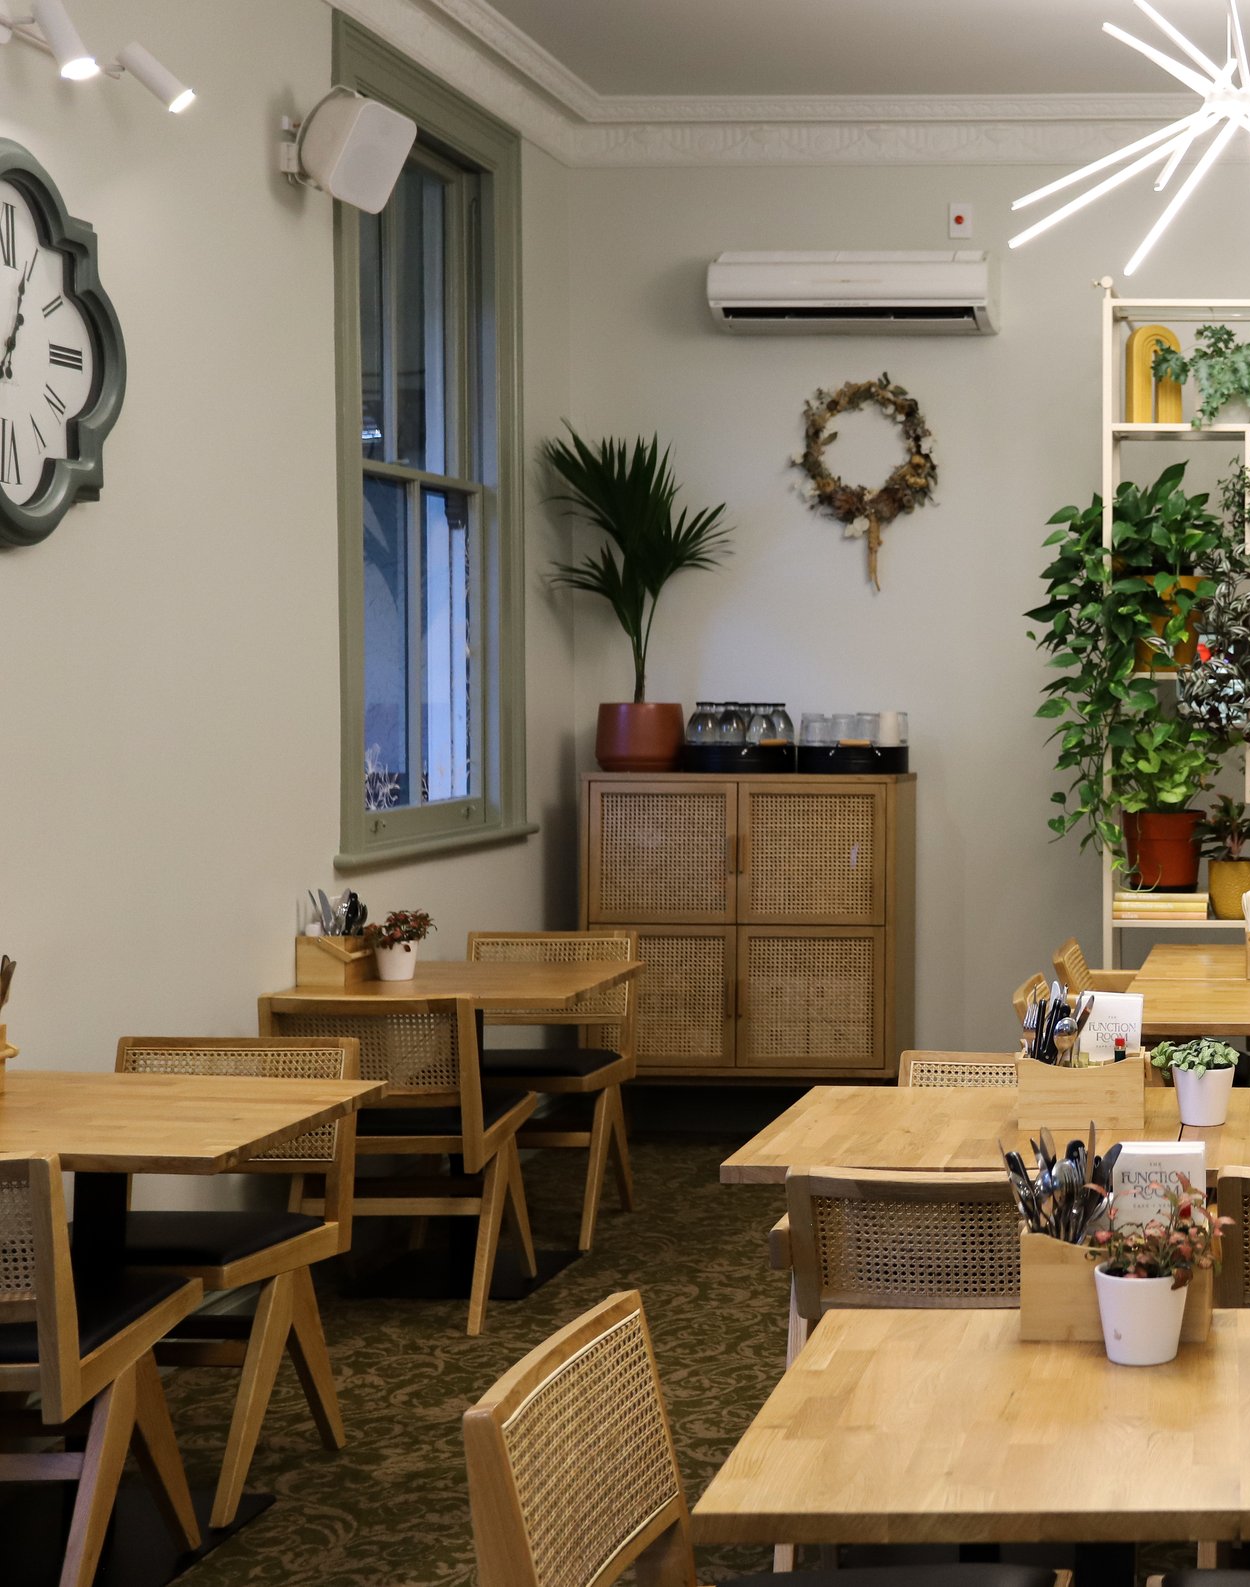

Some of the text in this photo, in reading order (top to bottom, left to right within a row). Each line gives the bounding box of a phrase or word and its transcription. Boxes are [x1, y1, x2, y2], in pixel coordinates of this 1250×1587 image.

[48, 340, 83, 374] III
[1088, 1021, 1136, 1032] FUNCTION
[1096, 1032, 1128, 1043] ROOM
